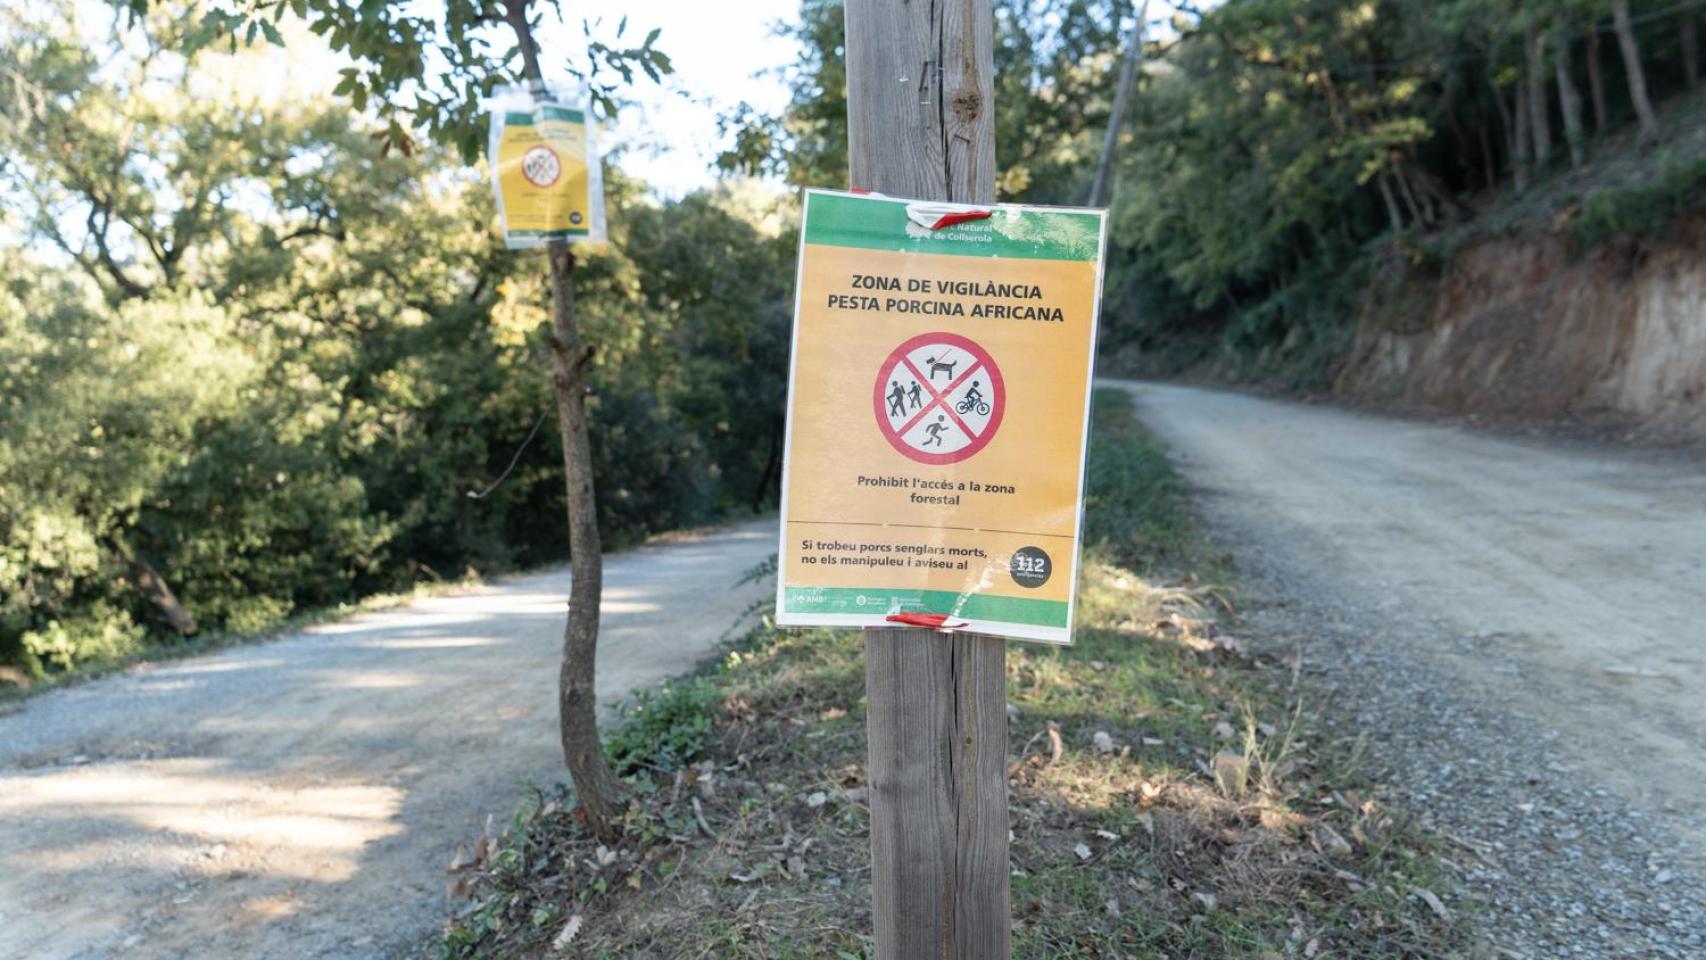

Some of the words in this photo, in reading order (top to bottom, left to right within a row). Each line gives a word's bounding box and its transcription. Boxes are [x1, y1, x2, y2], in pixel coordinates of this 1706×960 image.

[957, 223, 992, 233] Natural
[934, 232, 944, 240] de
[948, 232, 992, 243] Collserola
[852, 275, 901, 291] ZONA
[908, 279, 931, 293] DE
[937, 281, 1042, 299] VIGILÀNCIA
[828, 295, 880, 311] PESTA
[886, 299, 964, 316] PORCINA
[971, 305, 1064, 322] AFRICANA
[857, 476, 909, 488] Prohibit
[958, 482, 965, 491] a
[969, 481, 981, 492] la
[985, 484, 1016, 494] zona
[910, 493, 960, 506] forestal
[802, 540, 813, 550] Si
[816, 541, 856, 552] trobeu
[860, 543, 892, 555] porcs
[895, 543, 944, 557] senglars
[948, 547, 988, 559] morts,
[801, 556, 817, 565] no
[820, 555, 837, 565] els
[840, 556, 904, 570] manipuleu
[907, 557, 912, 568] i
[915, 558, 953, 570] aviseu
[957, 560, 968, 570] al
[1016, 555, 1045, 573] 112
